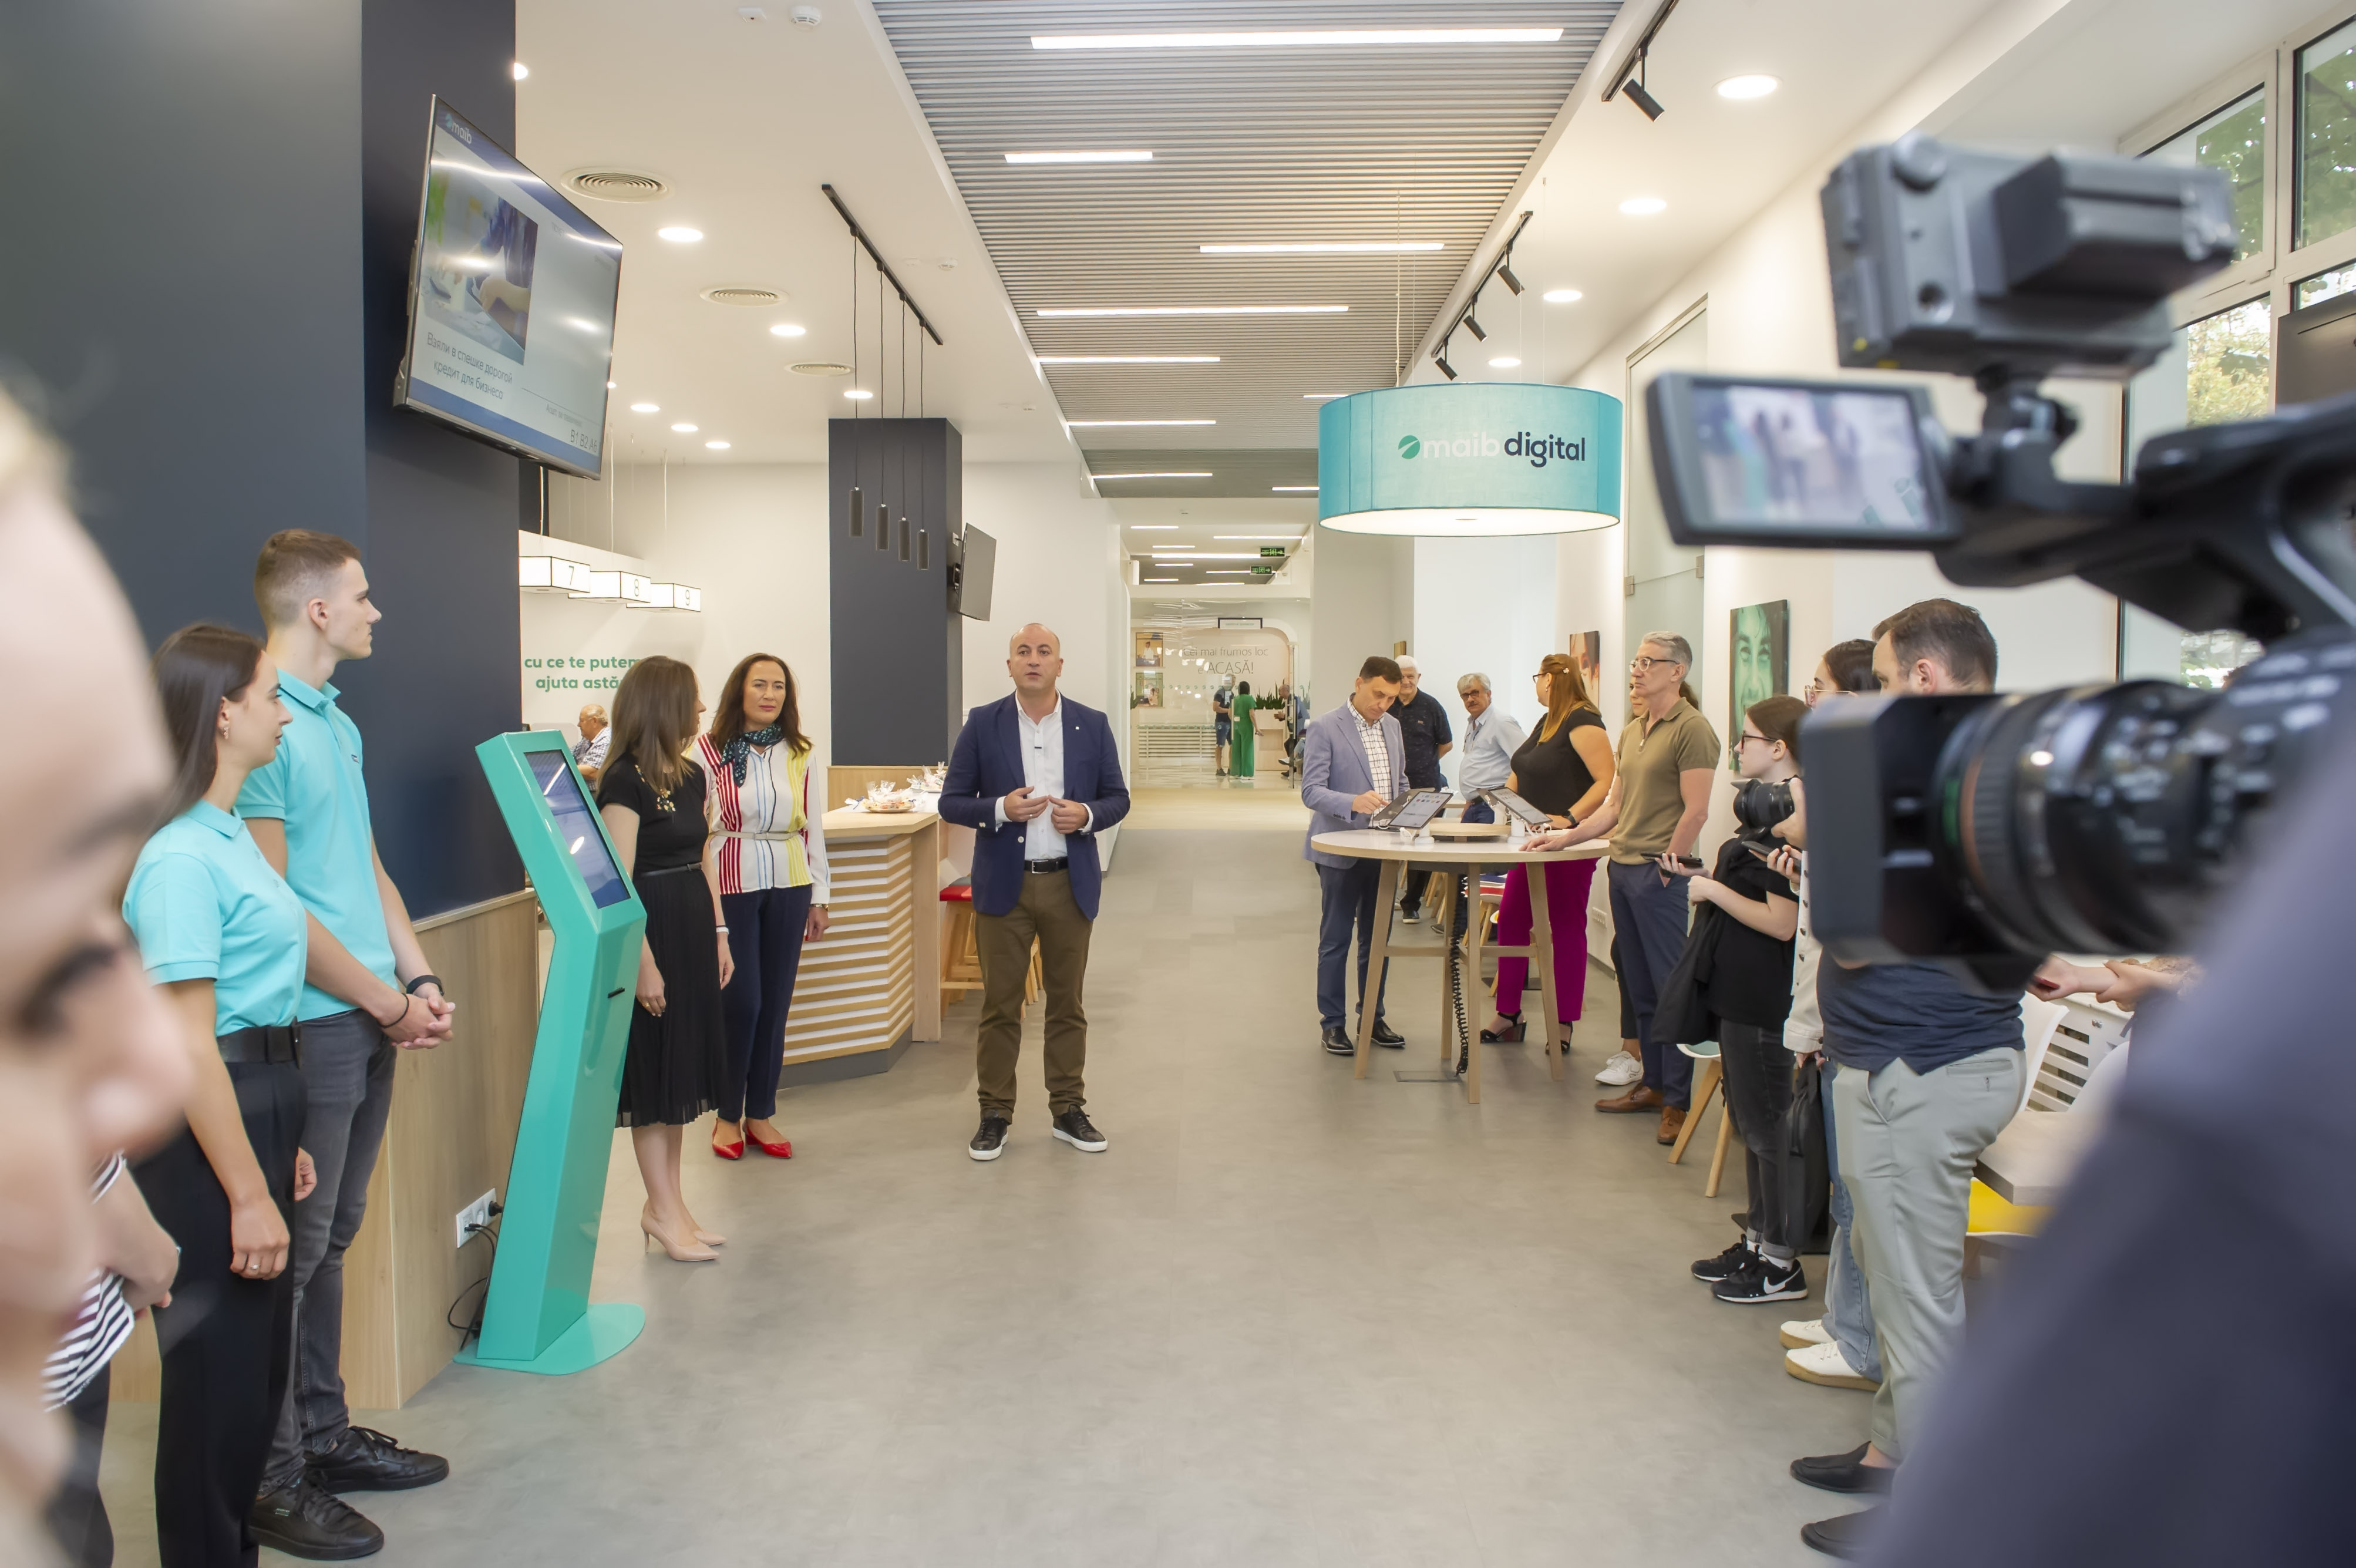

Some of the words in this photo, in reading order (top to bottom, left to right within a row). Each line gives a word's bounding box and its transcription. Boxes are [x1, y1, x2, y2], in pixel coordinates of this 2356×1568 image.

[451, 122, 472, 144] maib
[427, 332, 450, 354] Взяли
[452, 347, 456, 357] в
[457, 351, 484, 371] спешке
[484, 364, 513, 384] дорогой
[433, 360, 460, 379] кредит
[460, 373, 474, 386] для
[476, 377, 503, 400] бизнеса
[568, 565, 574, 586] 7
[634, 578, 640, 597] 8
[685, 590, 690, 606] 9
[1200, 647, 1217, 656] mai
[1220, 646, 1252, 656] frumos
[1255, 646, 1268, 656] loc
[524, 658, 542, 668] cu
[547, 658, 564, 668] ce
[569, 656, 585, 668] te
[1207, 659, 1253, 674] ACASĂ!
[536, 675, 578, 692] ajuta
[583, 675, 621, 689] astă
